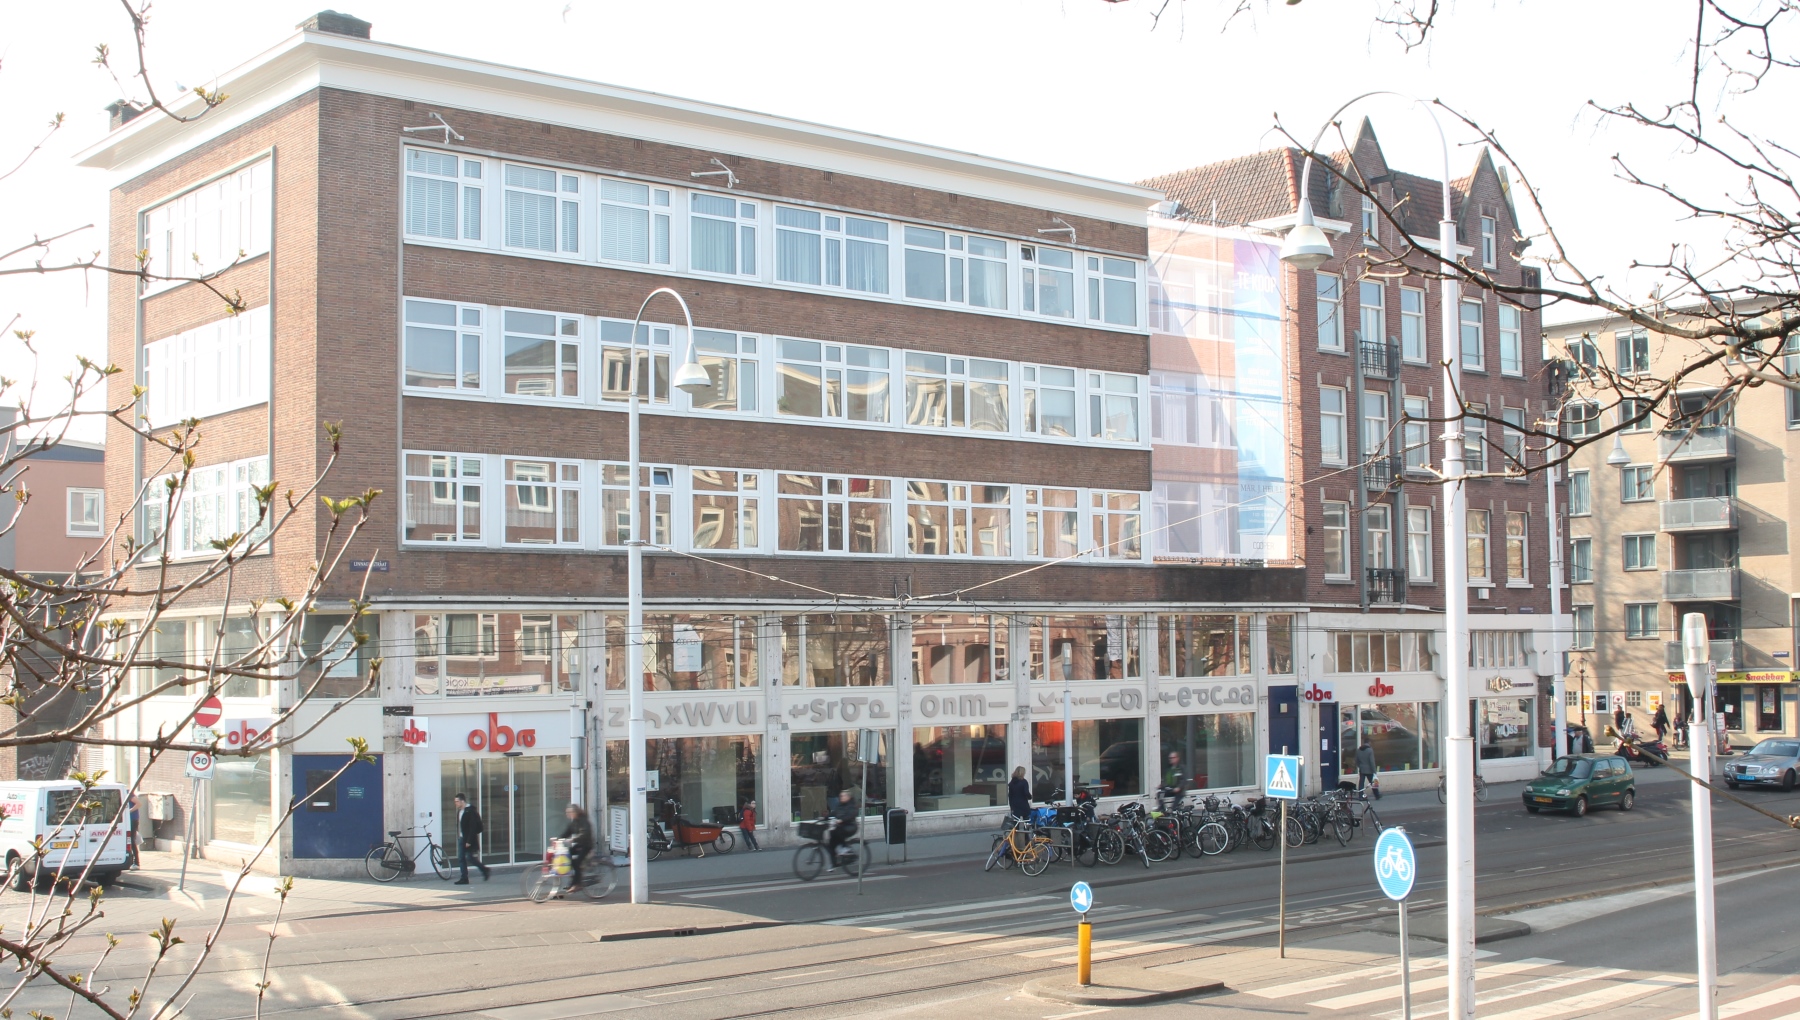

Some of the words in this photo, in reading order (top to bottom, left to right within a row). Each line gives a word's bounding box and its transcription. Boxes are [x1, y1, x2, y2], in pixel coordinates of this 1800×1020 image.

[1237, 271, 1249, 290] TE
[1252, 273, 1277, 293] KOOP
[1369, 677, 1394, 697] oba
[1745, 673, 1785, 681] Snackbar
[1305, 683, 1332, 701] oba
[403, 719, 427, 744] oba
[467, 712, 536, 753] oba
[194, 756, 208, 765] 30
